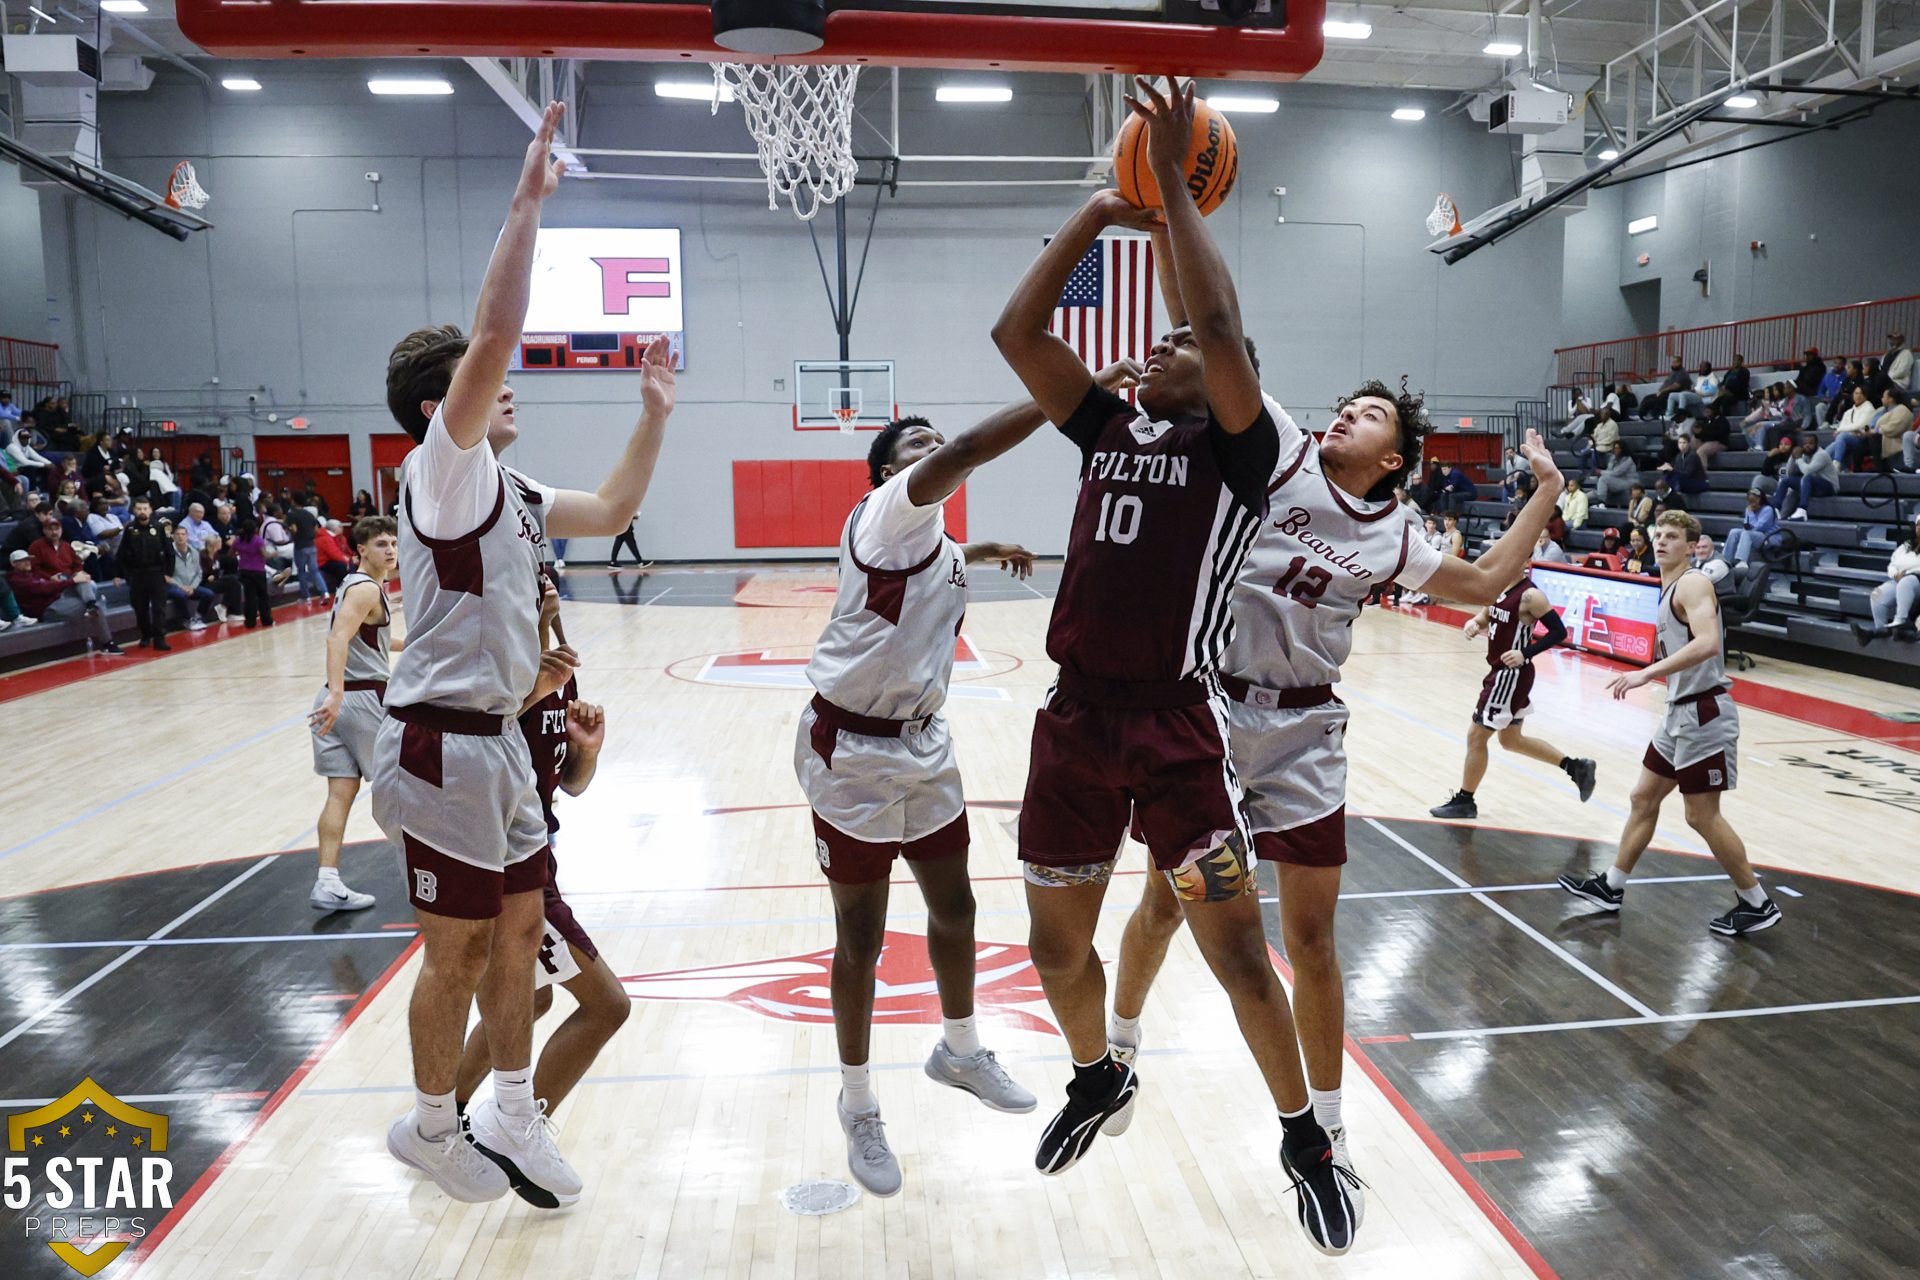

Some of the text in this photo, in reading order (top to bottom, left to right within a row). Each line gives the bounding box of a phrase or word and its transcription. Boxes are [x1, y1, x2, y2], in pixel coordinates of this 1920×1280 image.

[1088, 451, 1189, 487] FULTON
[1095, 492, 1144, 545] 10
[1273, 507, 1373, 580] Bearden
[1272, 556, 1333, 609] 12
[414, 867, 437, 903] B
